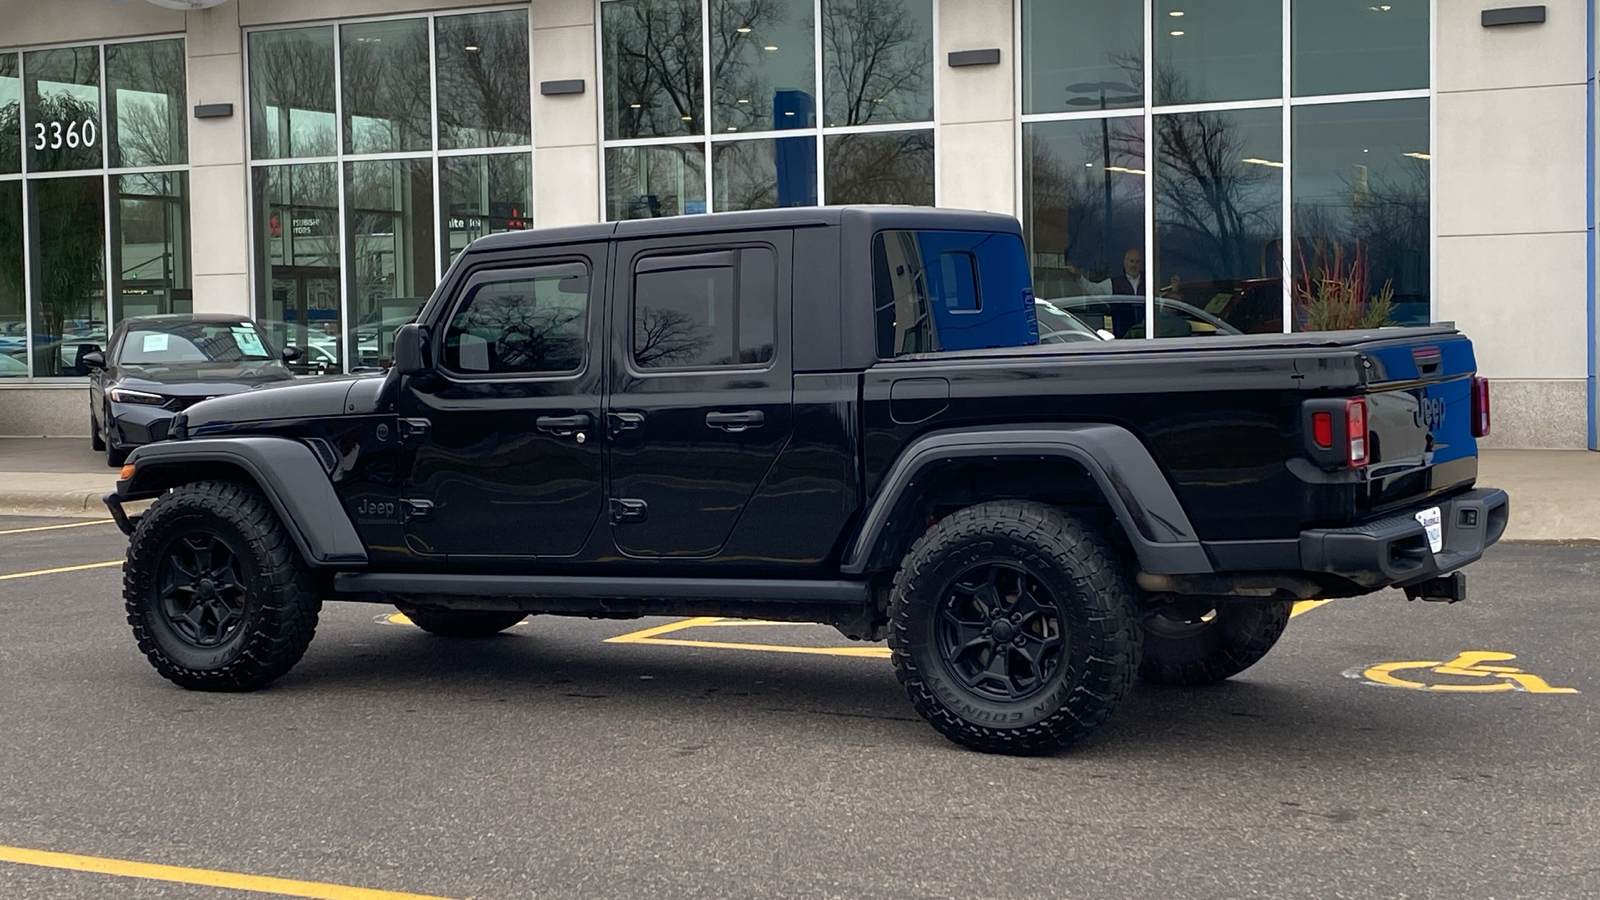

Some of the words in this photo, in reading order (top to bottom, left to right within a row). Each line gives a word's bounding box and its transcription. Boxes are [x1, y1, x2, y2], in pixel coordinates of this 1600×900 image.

[34, 119, 96, 150] 3360
[1414, 396, 1446, 430] Jeep
[357, 499, 395, 518] Jeep
